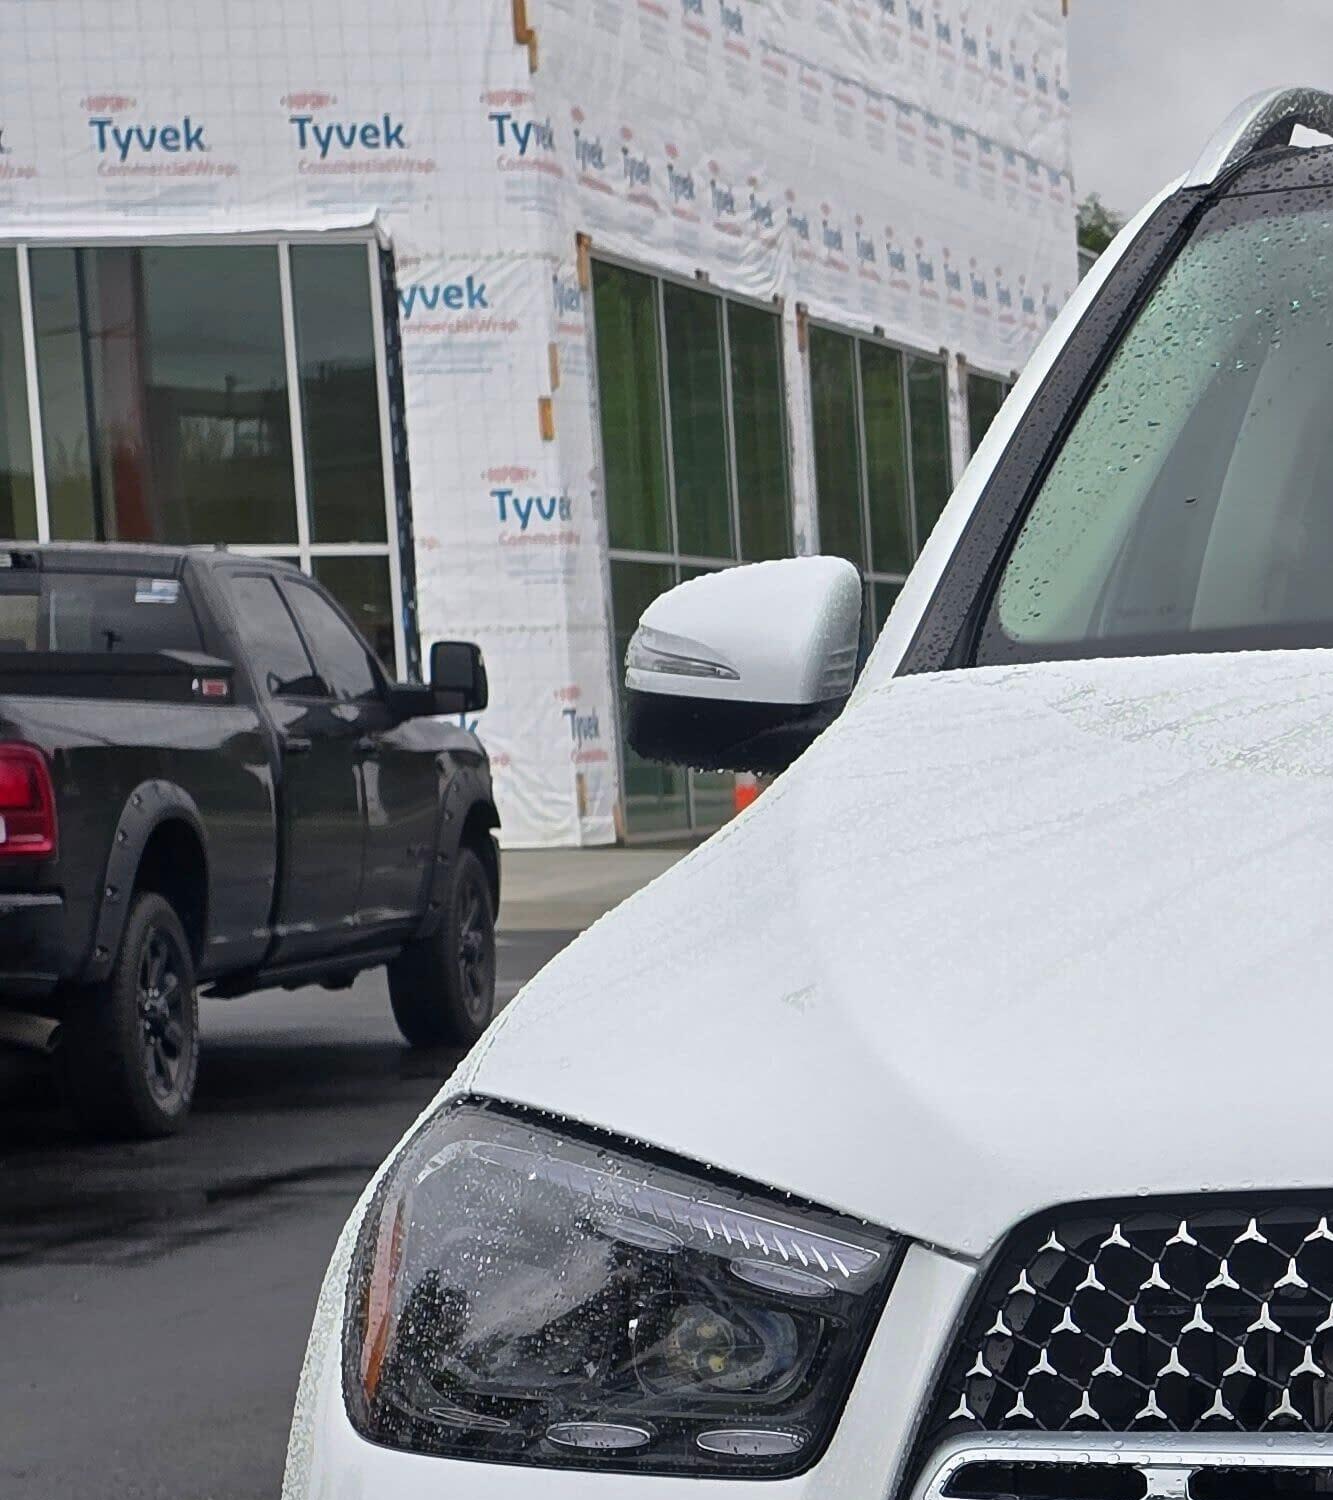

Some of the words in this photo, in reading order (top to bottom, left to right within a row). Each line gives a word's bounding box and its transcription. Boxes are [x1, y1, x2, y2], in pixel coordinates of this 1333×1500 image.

[89, 115, 206, 161] Tyvek
[289, 112, 405, 159] Tyvek
[398, 275, 489, 319] yvek
